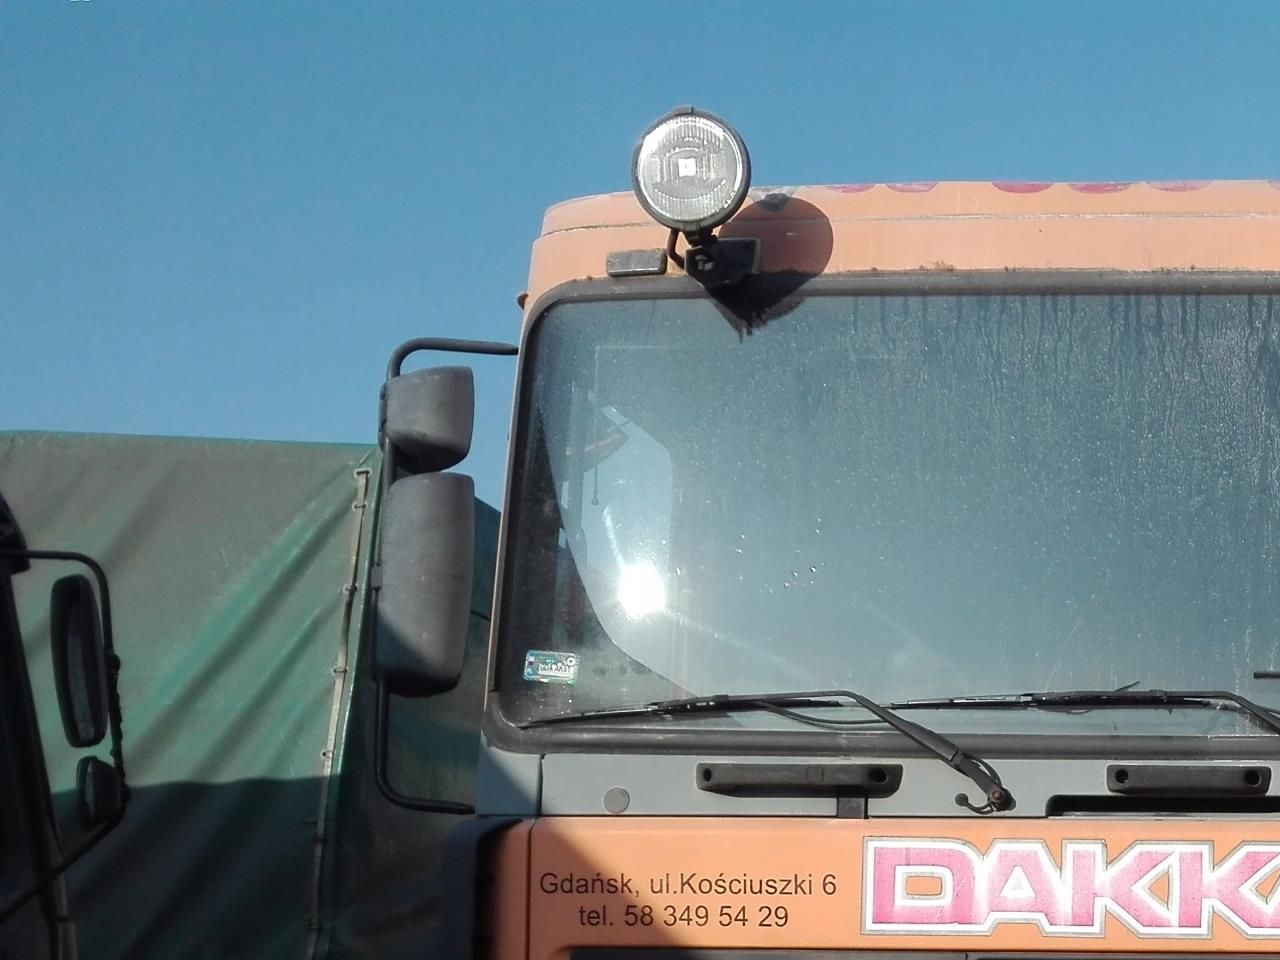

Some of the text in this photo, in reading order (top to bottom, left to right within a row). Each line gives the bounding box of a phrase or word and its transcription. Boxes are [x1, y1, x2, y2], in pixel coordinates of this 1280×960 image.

[539, 872, 837, 897] Gdańsk, ul.Kościuszki 6
[578, 905, 788, 928] tel. 58 349 54 29
